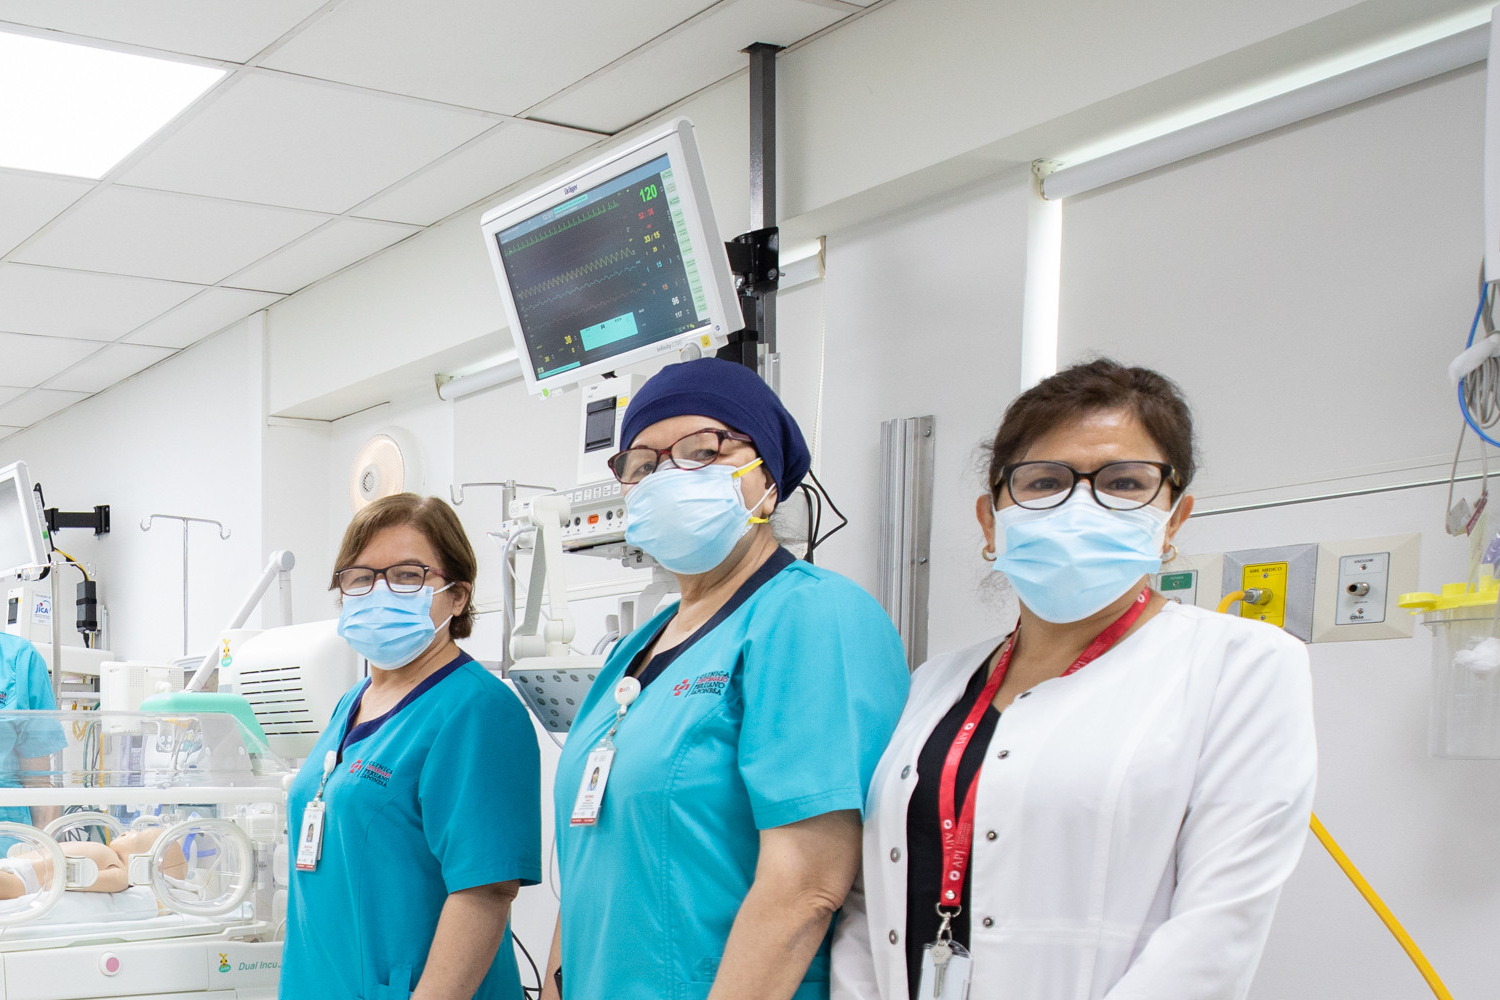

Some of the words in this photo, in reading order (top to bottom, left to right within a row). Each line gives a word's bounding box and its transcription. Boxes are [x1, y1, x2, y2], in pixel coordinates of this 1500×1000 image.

[640, 184, 657, 202] 120
[239, 961, 258, 970] Dual
[260, 961, 278, 969] Incu
